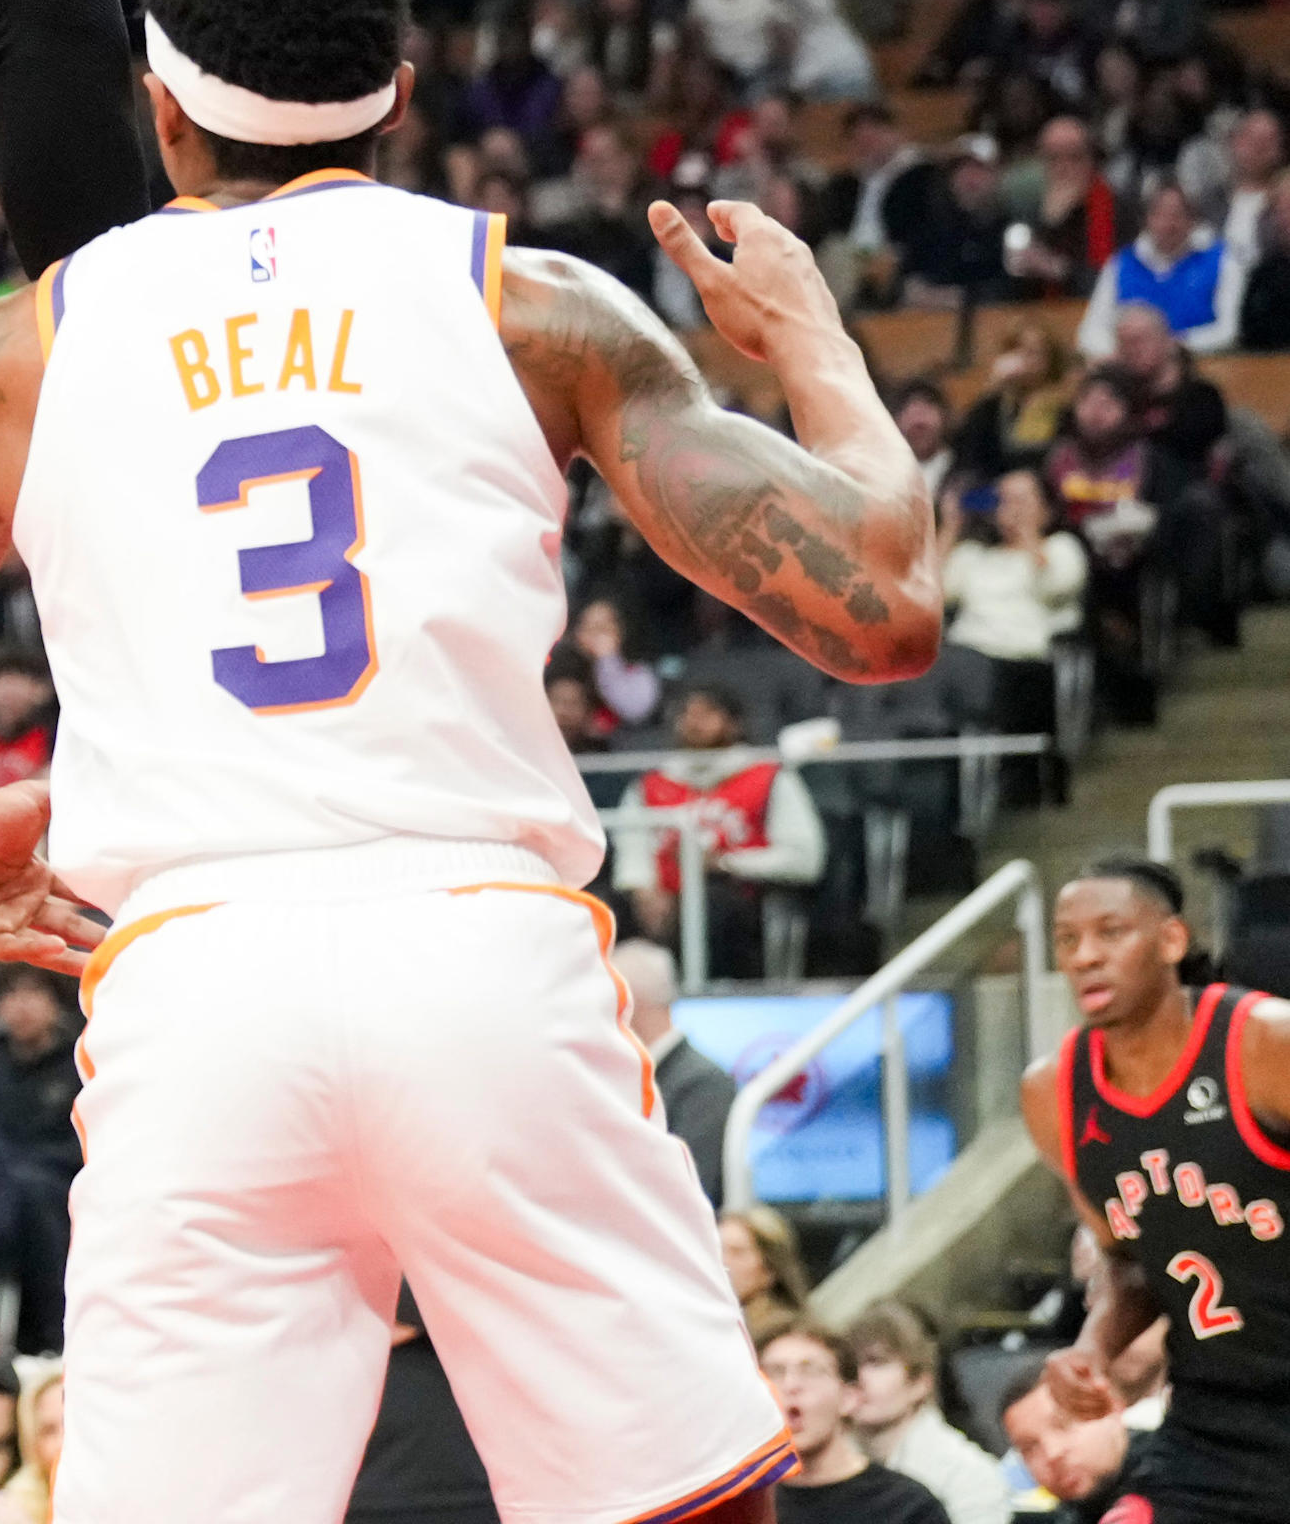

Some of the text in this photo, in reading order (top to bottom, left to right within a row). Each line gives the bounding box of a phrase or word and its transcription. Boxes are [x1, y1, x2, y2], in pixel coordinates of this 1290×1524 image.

[168, 308, 363, 412] BEAL
[195, 424, 380, 716] 3
[1165, 1250, 1245, 1341] 2
